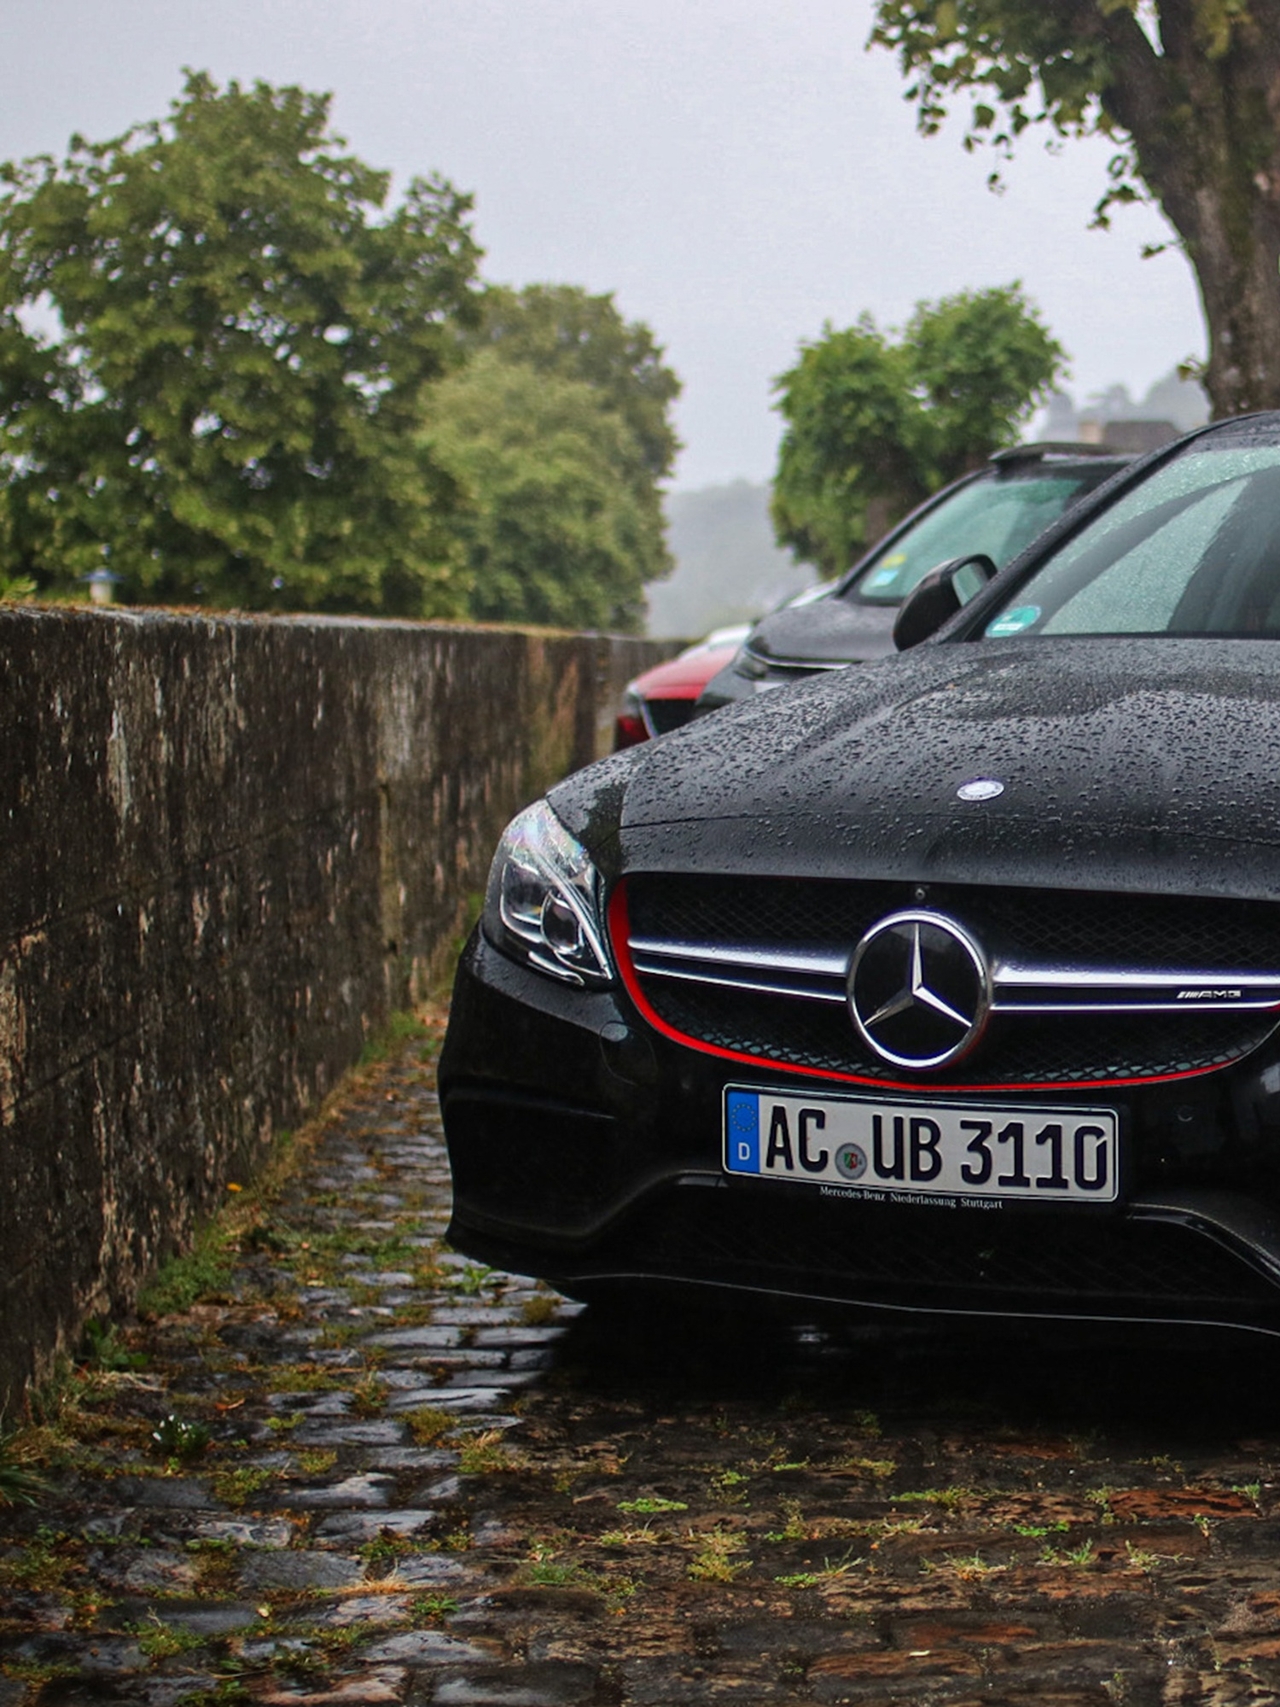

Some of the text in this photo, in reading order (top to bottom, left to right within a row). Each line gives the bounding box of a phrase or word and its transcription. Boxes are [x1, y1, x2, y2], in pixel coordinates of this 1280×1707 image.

[737, 1142, 751, 1161] D
[766, 1105, 1109, 1190] AC UB 3110
[819, 1186, 1004, 1210] Mercedes-Benz Niederlassung Stuttgart
